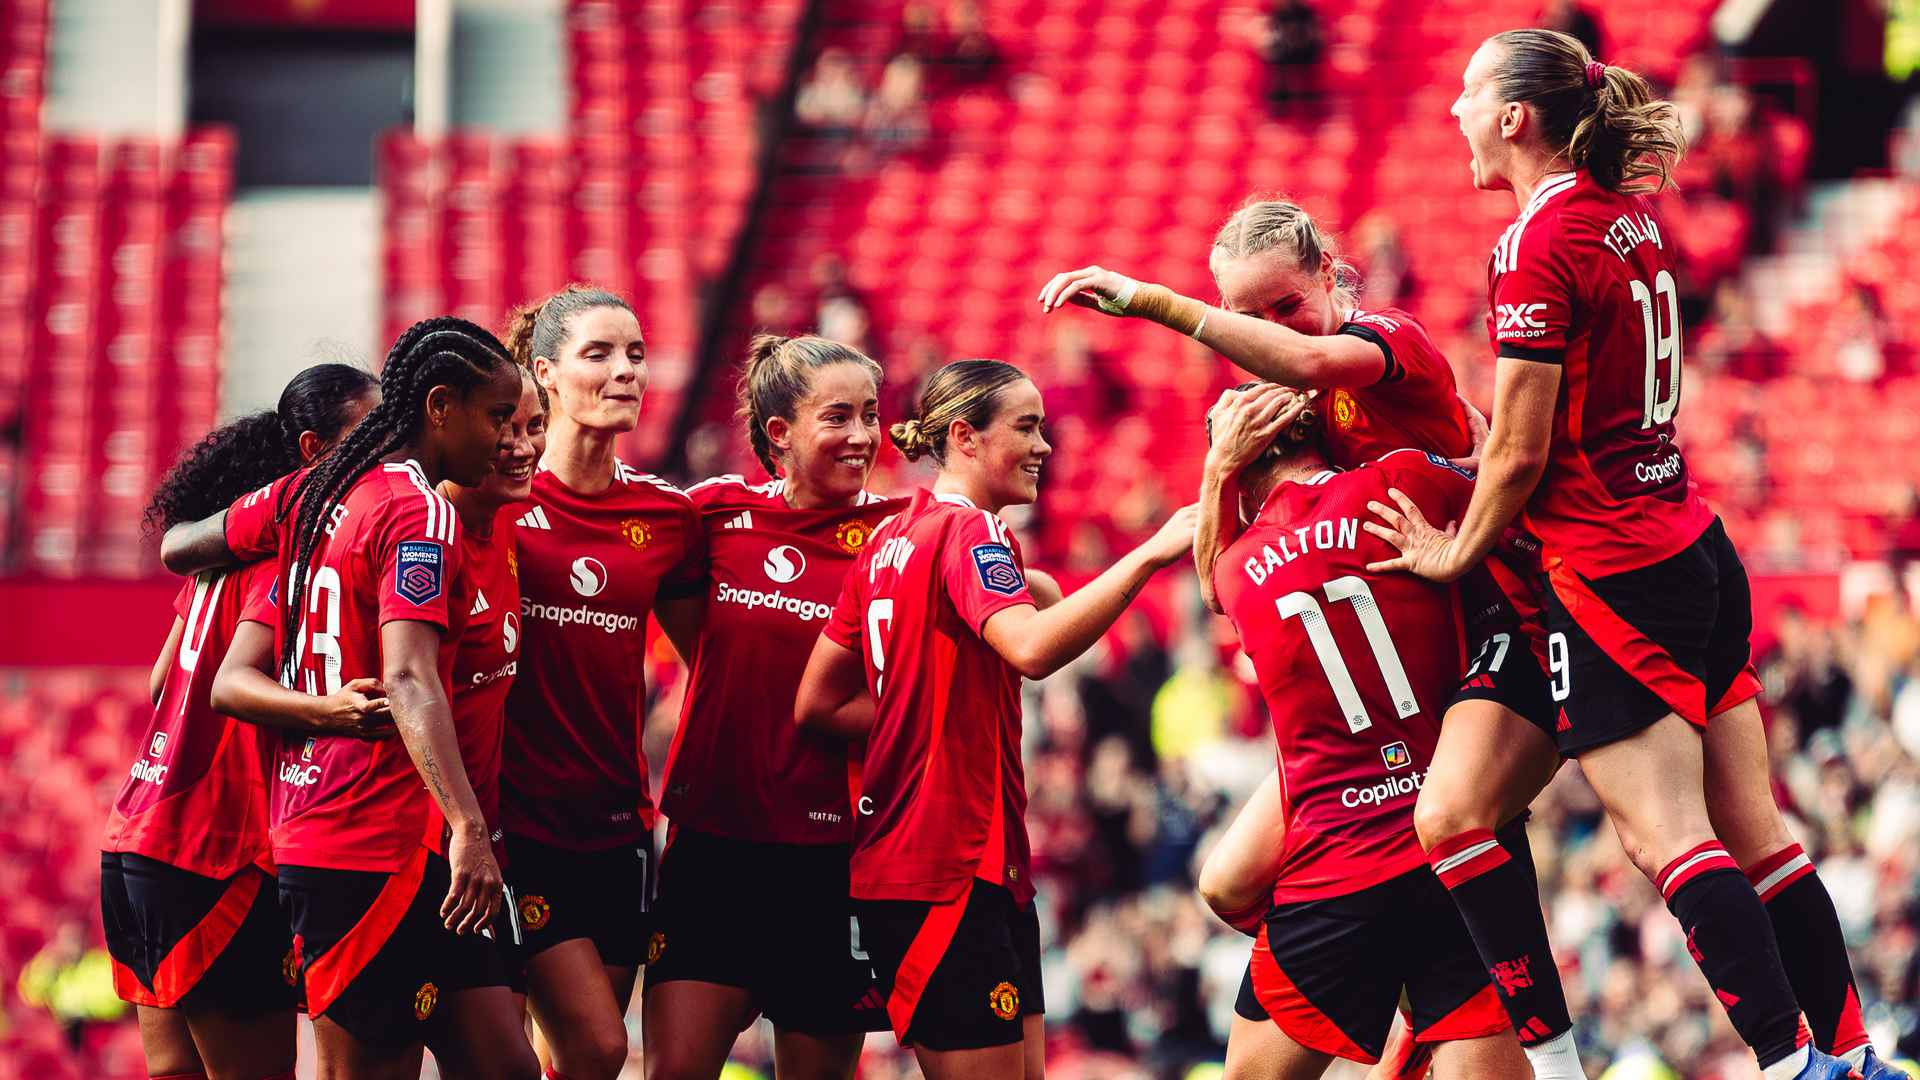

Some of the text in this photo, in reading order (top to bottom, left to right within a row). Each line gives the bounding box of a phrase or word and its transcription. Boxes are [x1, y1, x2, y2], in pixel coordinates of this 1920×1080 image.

[1629, 269, 1683, 430] 19
[401, 551, 438, 560] WOMEN'S
[1244, 517, 1358, 586] GALTON
[520, 597, 638, 634] Snapdragon
[1275, 575, 1421, 735] 11
[1549, 631, 1571, 702] 9
